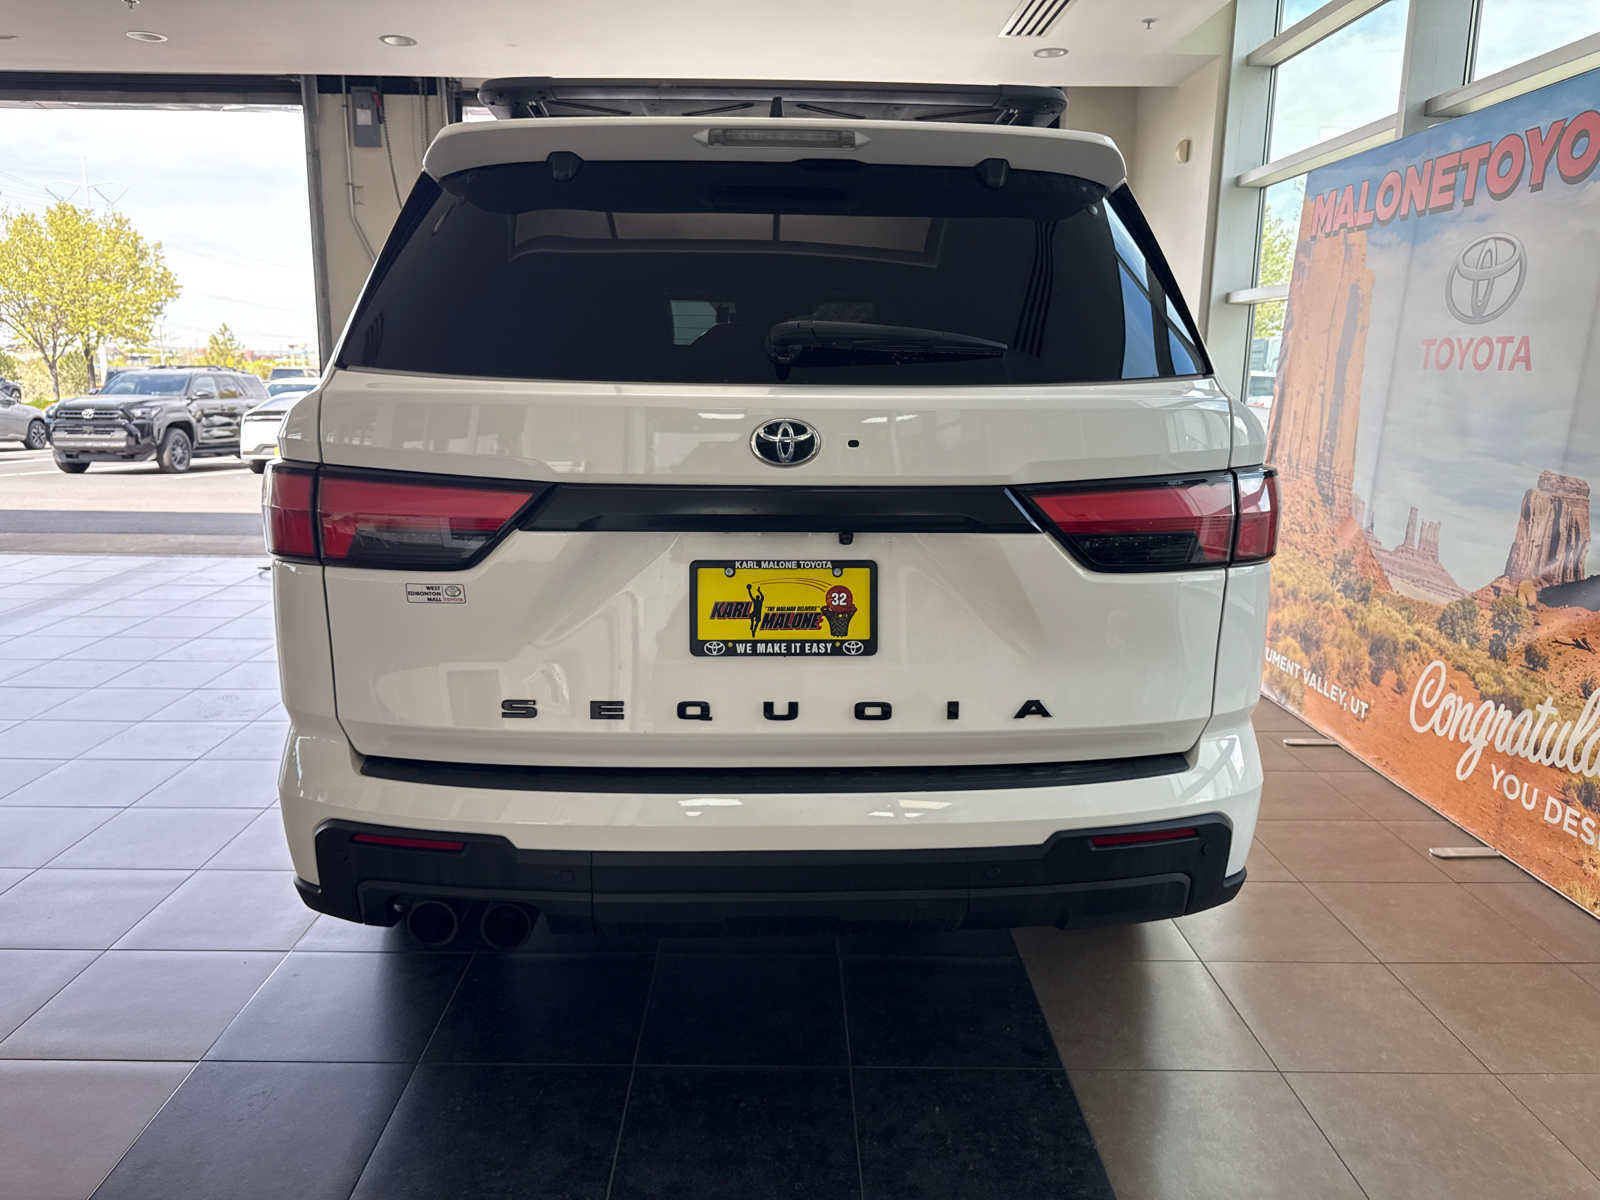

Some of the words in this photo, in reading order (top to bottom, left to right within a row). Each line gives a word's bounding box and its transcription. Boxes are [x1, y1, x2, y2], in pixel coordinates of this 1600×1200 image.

[1421, 335, 1532, 372] TOYOTA
[735, 561, 759, 569] KARL
[761, 561, 797, 569] MALONE
[800, 561, 832, 569] TOYOTA
[831, 592, 847, 606] 32
[709, 601, 752, 619] KARL
[759, 612, 823, 631] MALONE
[736, 643, 752, 654] WE
[757, 643, 787, 654] MAKE
[791, 643, 801, 654] IT
[805, 643, 832, 654] EASY
[1265, 646, 1301, 679] UMENT
[1303, 668, 1347, 711] VALLEY,
[1350, 696, 1369, 719] UT
[501, 698, 1053, 721] SEQUOIA
[1490, 764, 1538, 811] YOU
[1543, 795, 1600, 851] DES
